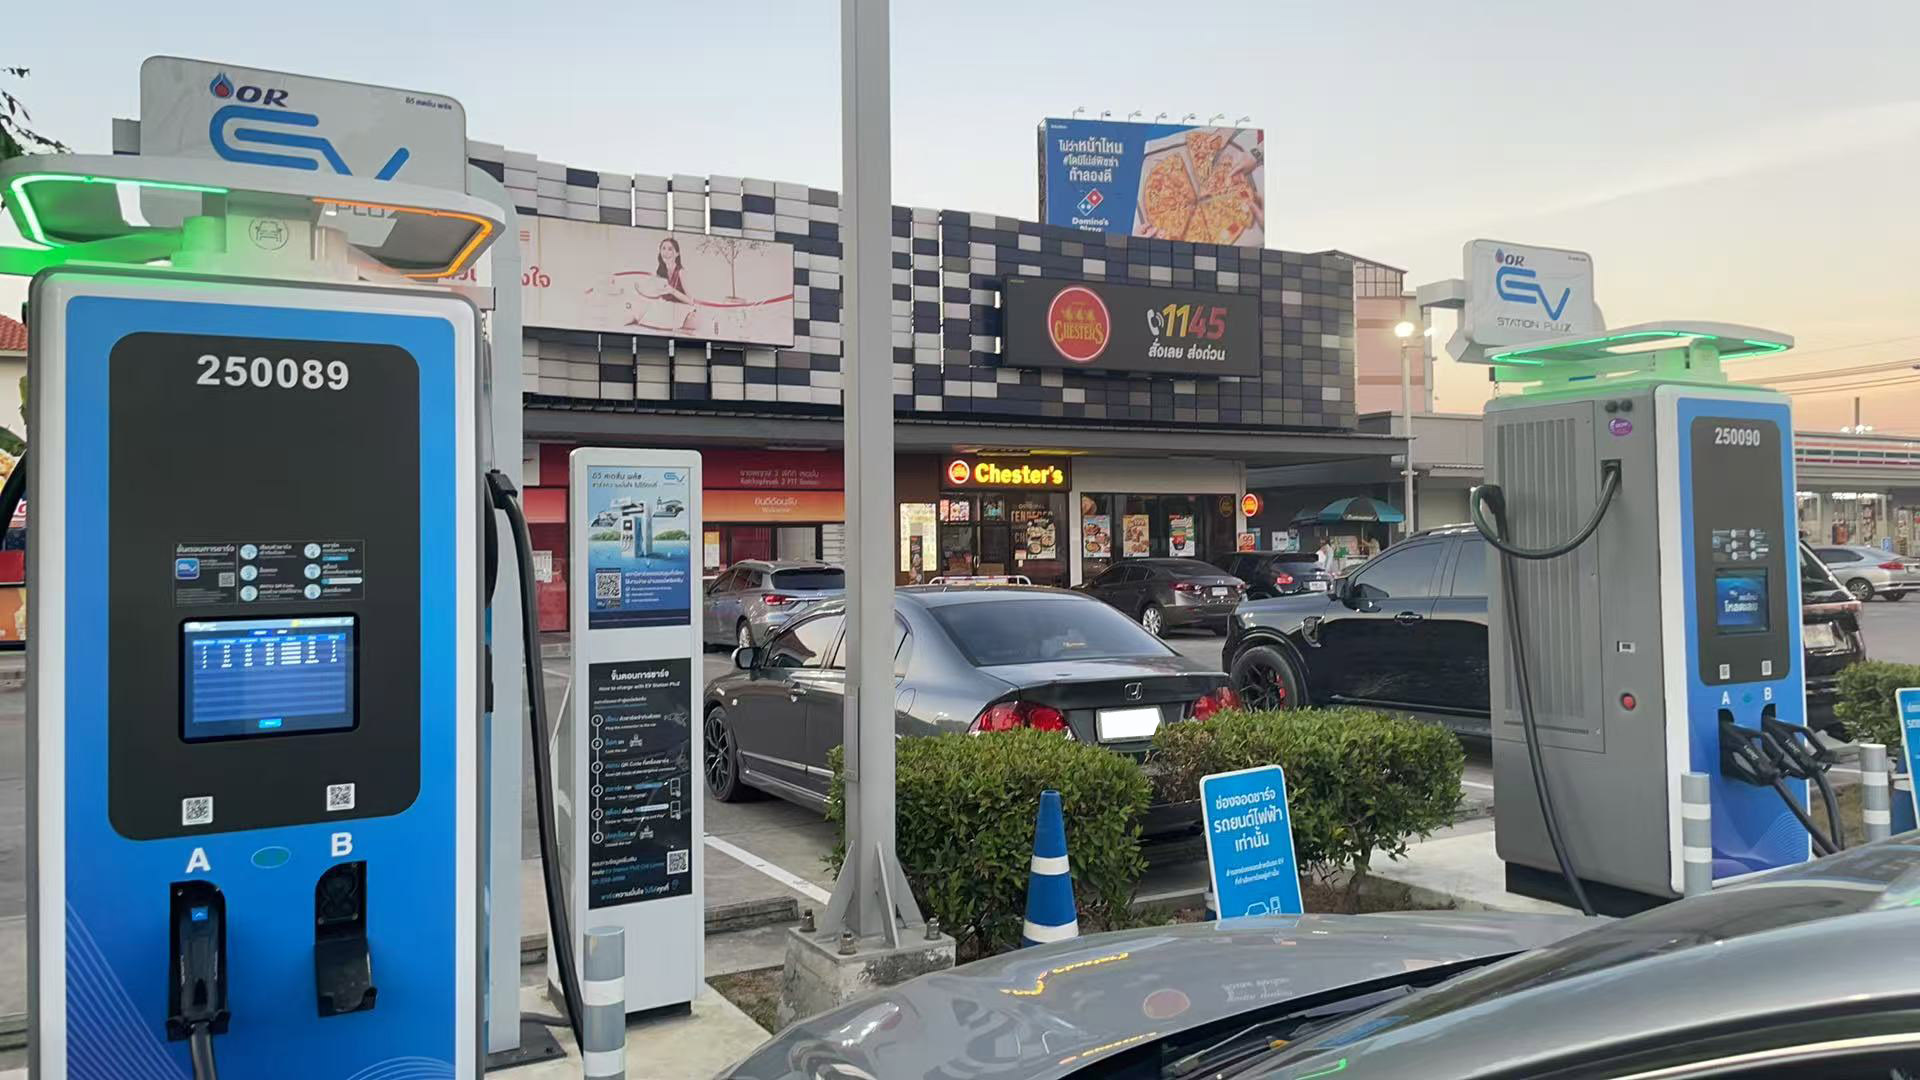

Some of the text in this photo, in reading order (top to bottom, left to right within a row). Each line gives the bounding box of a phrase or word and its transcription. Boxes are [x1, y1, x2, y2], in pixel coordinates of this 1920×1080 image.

[236, 85, 289, 108] OR
[1072, 216, 1110, 227] Domino's
[1504, 253, 1526, 267] OR
[1496, 265, 1571, 321] EV
[1162, 303, 1227, 341] 1145
[1496, 316, 1540, 329] STATION
[1187, 344, 1226, 361] ส่งด่วน
[196, 354, 350, 391] 250089
[1715, 427, 1761, 447] 250090
[975, 462, 1064, 485] Chester's
[1721, 691, 1731, 705] A
[1764, 687, 1772, 700] B
[1215, 786, 1276, 810] ช่องจอดชาร์จ
[1214, 805, 1283, 833] รถยนต์ไฟฟ้า
[331, 833, 353, 857] B
[1235, 826, 1270, 852] เท่านั้น
[186, 848, 212, 874] A
